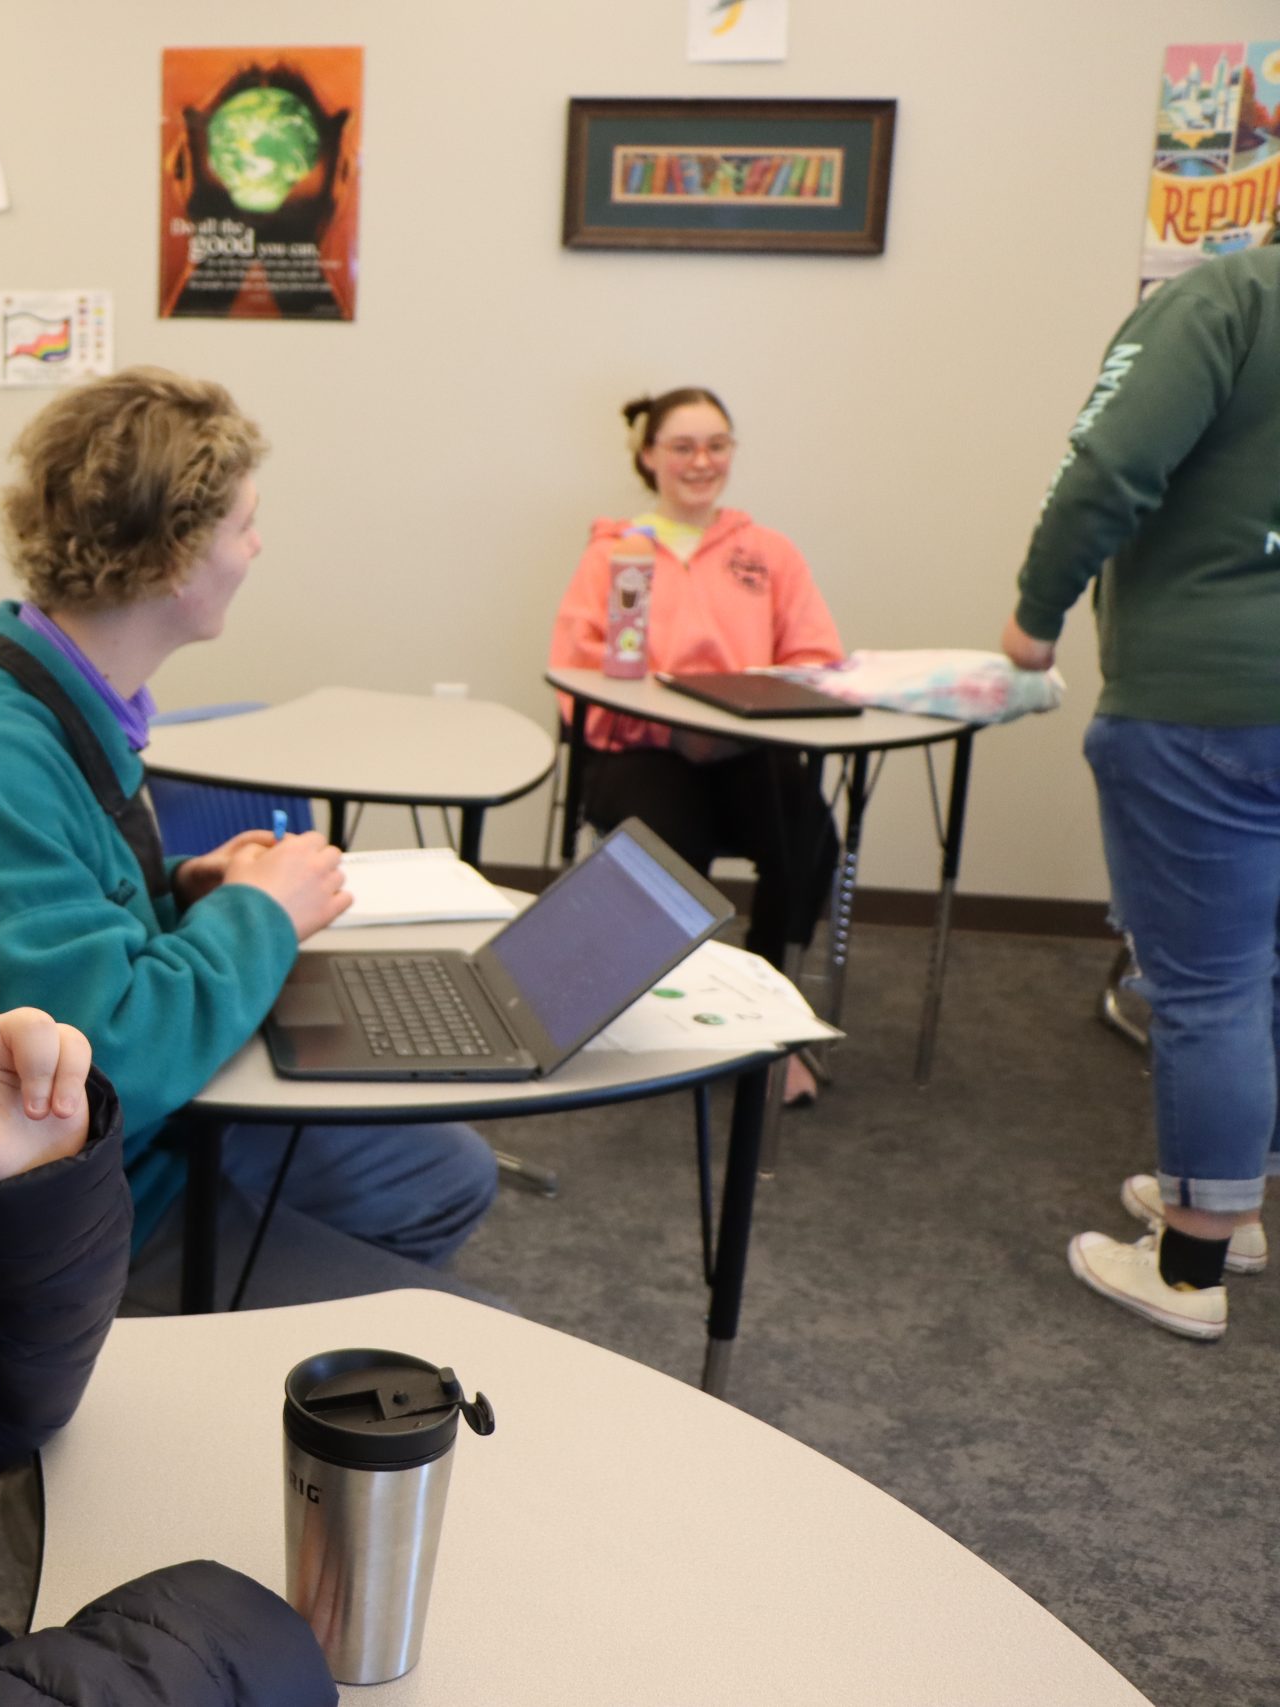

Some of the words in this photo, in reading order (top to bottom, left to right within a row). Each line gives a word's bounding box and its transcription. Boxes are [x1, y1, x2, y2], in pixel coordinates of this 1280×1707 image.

[1160, 161, 1280, 245] READI
[188, 227, 255, 264] good
[257, 243, 286, 259] you
